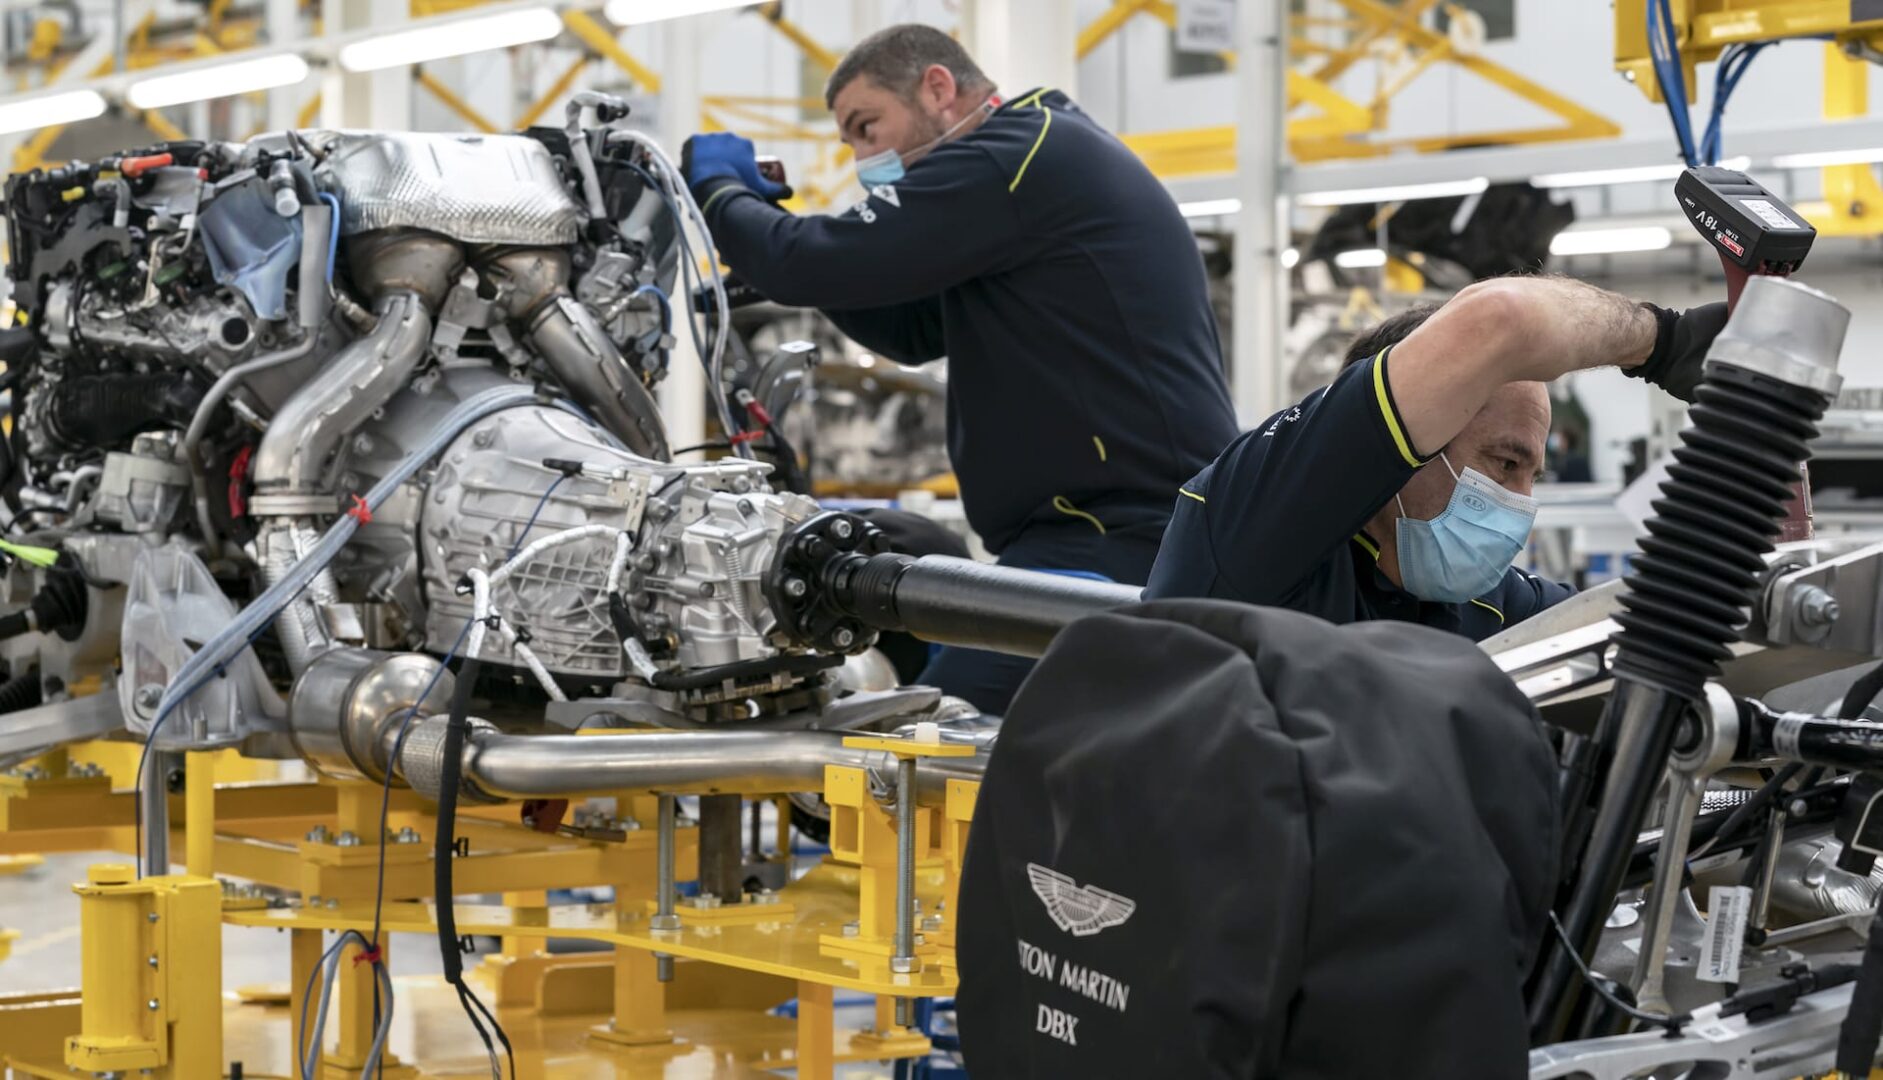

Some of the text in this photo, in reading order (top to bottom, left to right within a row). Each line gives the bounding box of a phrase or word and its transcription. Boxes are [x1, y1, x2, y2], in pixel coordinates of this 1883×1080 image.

[1696, 211, 1718, 231] 18 V
[1059, 959, 1130, 1013] MARTIN
[1036, 1003, 1080, 1046] DBX
